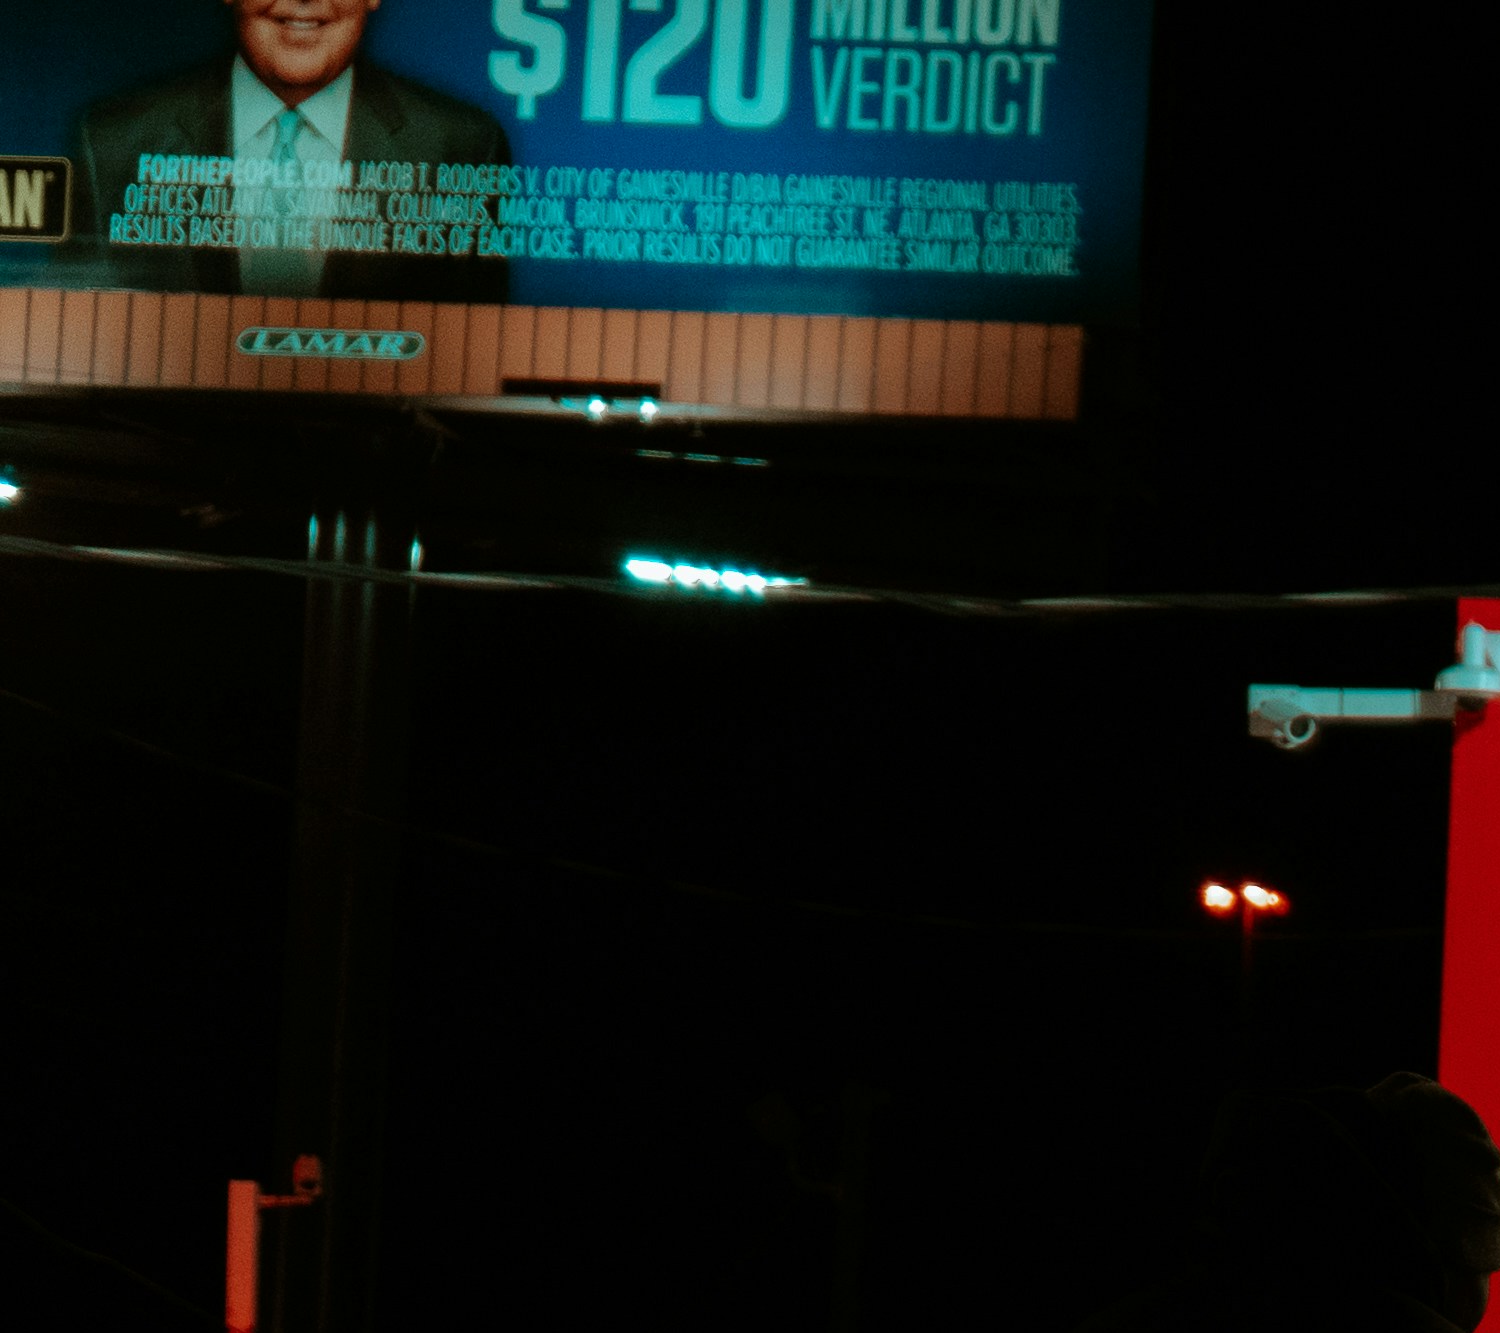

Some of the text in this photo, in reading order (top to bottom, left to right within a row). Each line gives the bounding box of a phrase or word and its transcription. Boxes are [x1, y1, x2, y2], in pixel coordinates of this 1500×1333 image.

[488, 0, 795, 128] $120
[809, 46, 1058, 135] VERDICT
[138, 153, 352, 189] FORTHEPEOPLE.COM
[356, 160, 413, 190] JACOB
[418, 162, 431, 192] T.
[437, 163, 522, 195] RODGERS
[545, 166, 585, 197] CITY
[588, 167, 615, 199] OF
[617, 168, 730, 200] GAINESVILLE
[783, 173, 897, 208] GAINESVILLE
[124, 183, 198, 214] OFFICES
[727, 204, 829, 236] PEACHTREE
[983, 211, 1010, 241] GA
[109, 213, 185, 244] RESULTS
[189, 215, 245, 247] BASED
[251, 217, 275, 247] ON
[282, 218, 313, 248] THE
[319, 219, 389, 252] UNIQUE
[391, 224, 446, 253] FACTS
[449, 225, 474, 254] OF
[477, 225, 525, 256] EACH
[528, 227, 578, 259] CASE.
[583, 228, 641, 262] PRIOR
[643, 231, 721, 264] RESULTS
[723, 234, 752, 265] DO
[755, 234, 793, 266] NOT
[795, 235, 900, 270] GUARANTEE
[903, 239, 979, 272] SIMILAR
[251, 330, 404, 357] LAMAR
